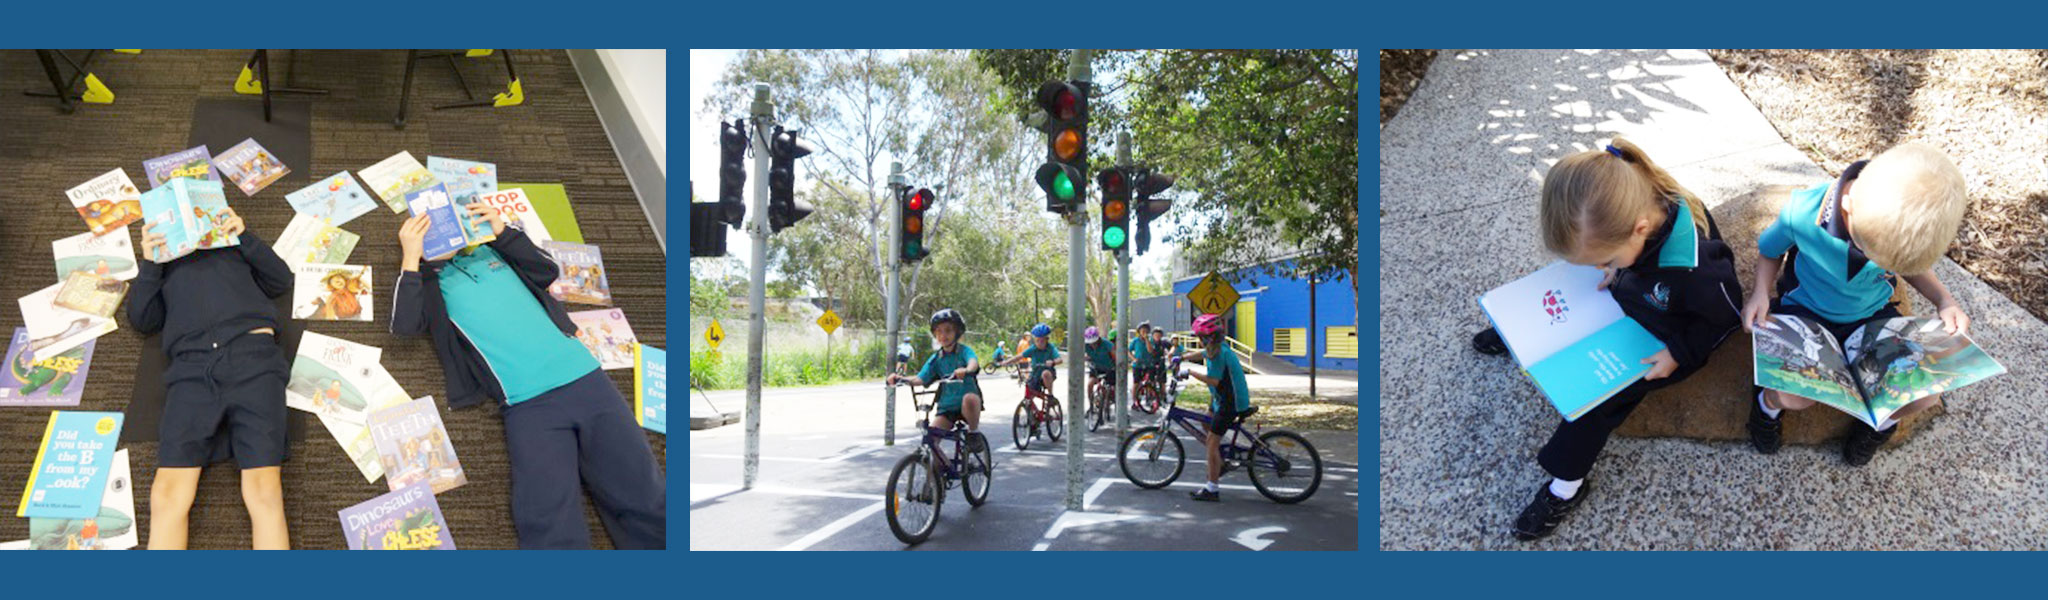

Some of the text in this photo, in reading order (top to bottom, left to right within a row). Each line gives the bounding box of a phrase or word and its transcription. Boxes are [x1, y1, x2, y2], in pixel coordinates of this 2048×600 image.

[73, 175, 120, 200] Ordinary
[93, 186, 116, 200] Day
[484, 192, 519, 206] TOP
[56, 430, 79, 440] Did
[53, 440, 104, 451] you take
[57, 450, 95, 465] the B
[45, 463, 98, 476] from my
[347, 486, 424, 532] Dinosaurs
[366, 518, 394, 537] Love
